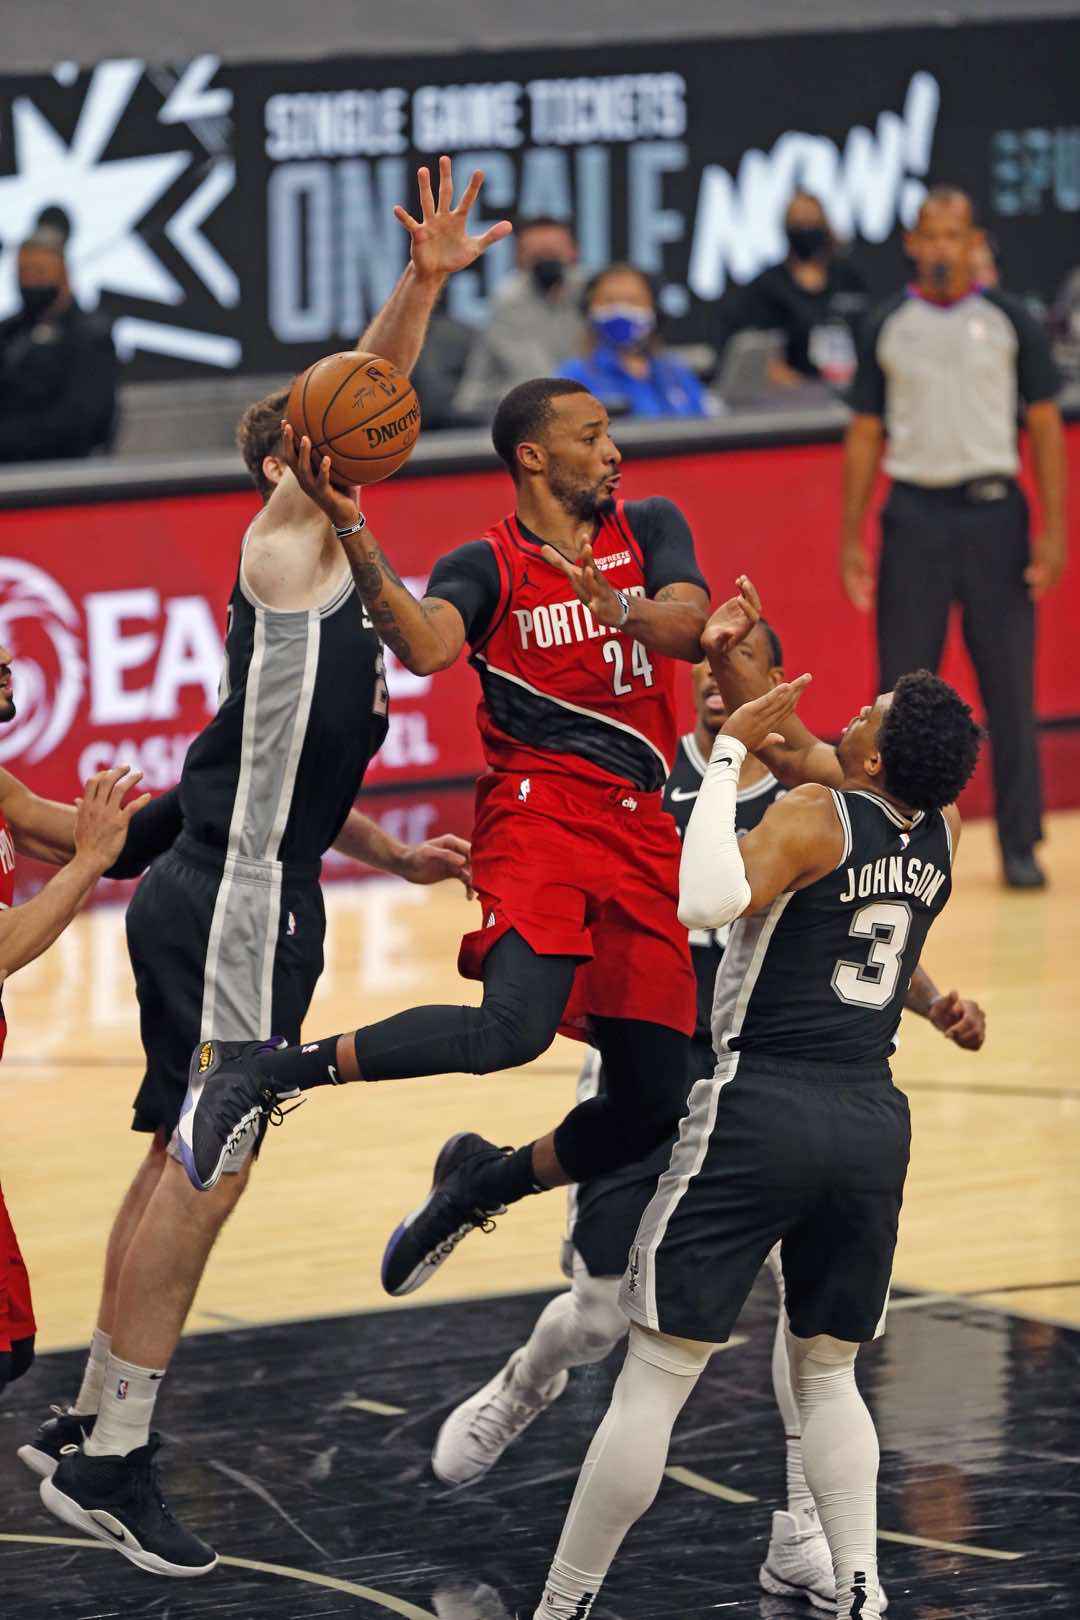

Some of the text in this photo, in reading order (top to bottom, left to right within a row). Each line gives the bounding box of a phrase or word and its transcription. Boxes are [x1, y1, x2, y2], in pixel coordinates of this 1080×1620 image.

[265, 72, 687, 160] SINGLE GAME TICKETS
[512, 585, 646, 650] PORTL
[602, 638, 654, 696] 24
[839, 855, 946, 908] JOHNSON
[830, 900, 913, 1011] 3
